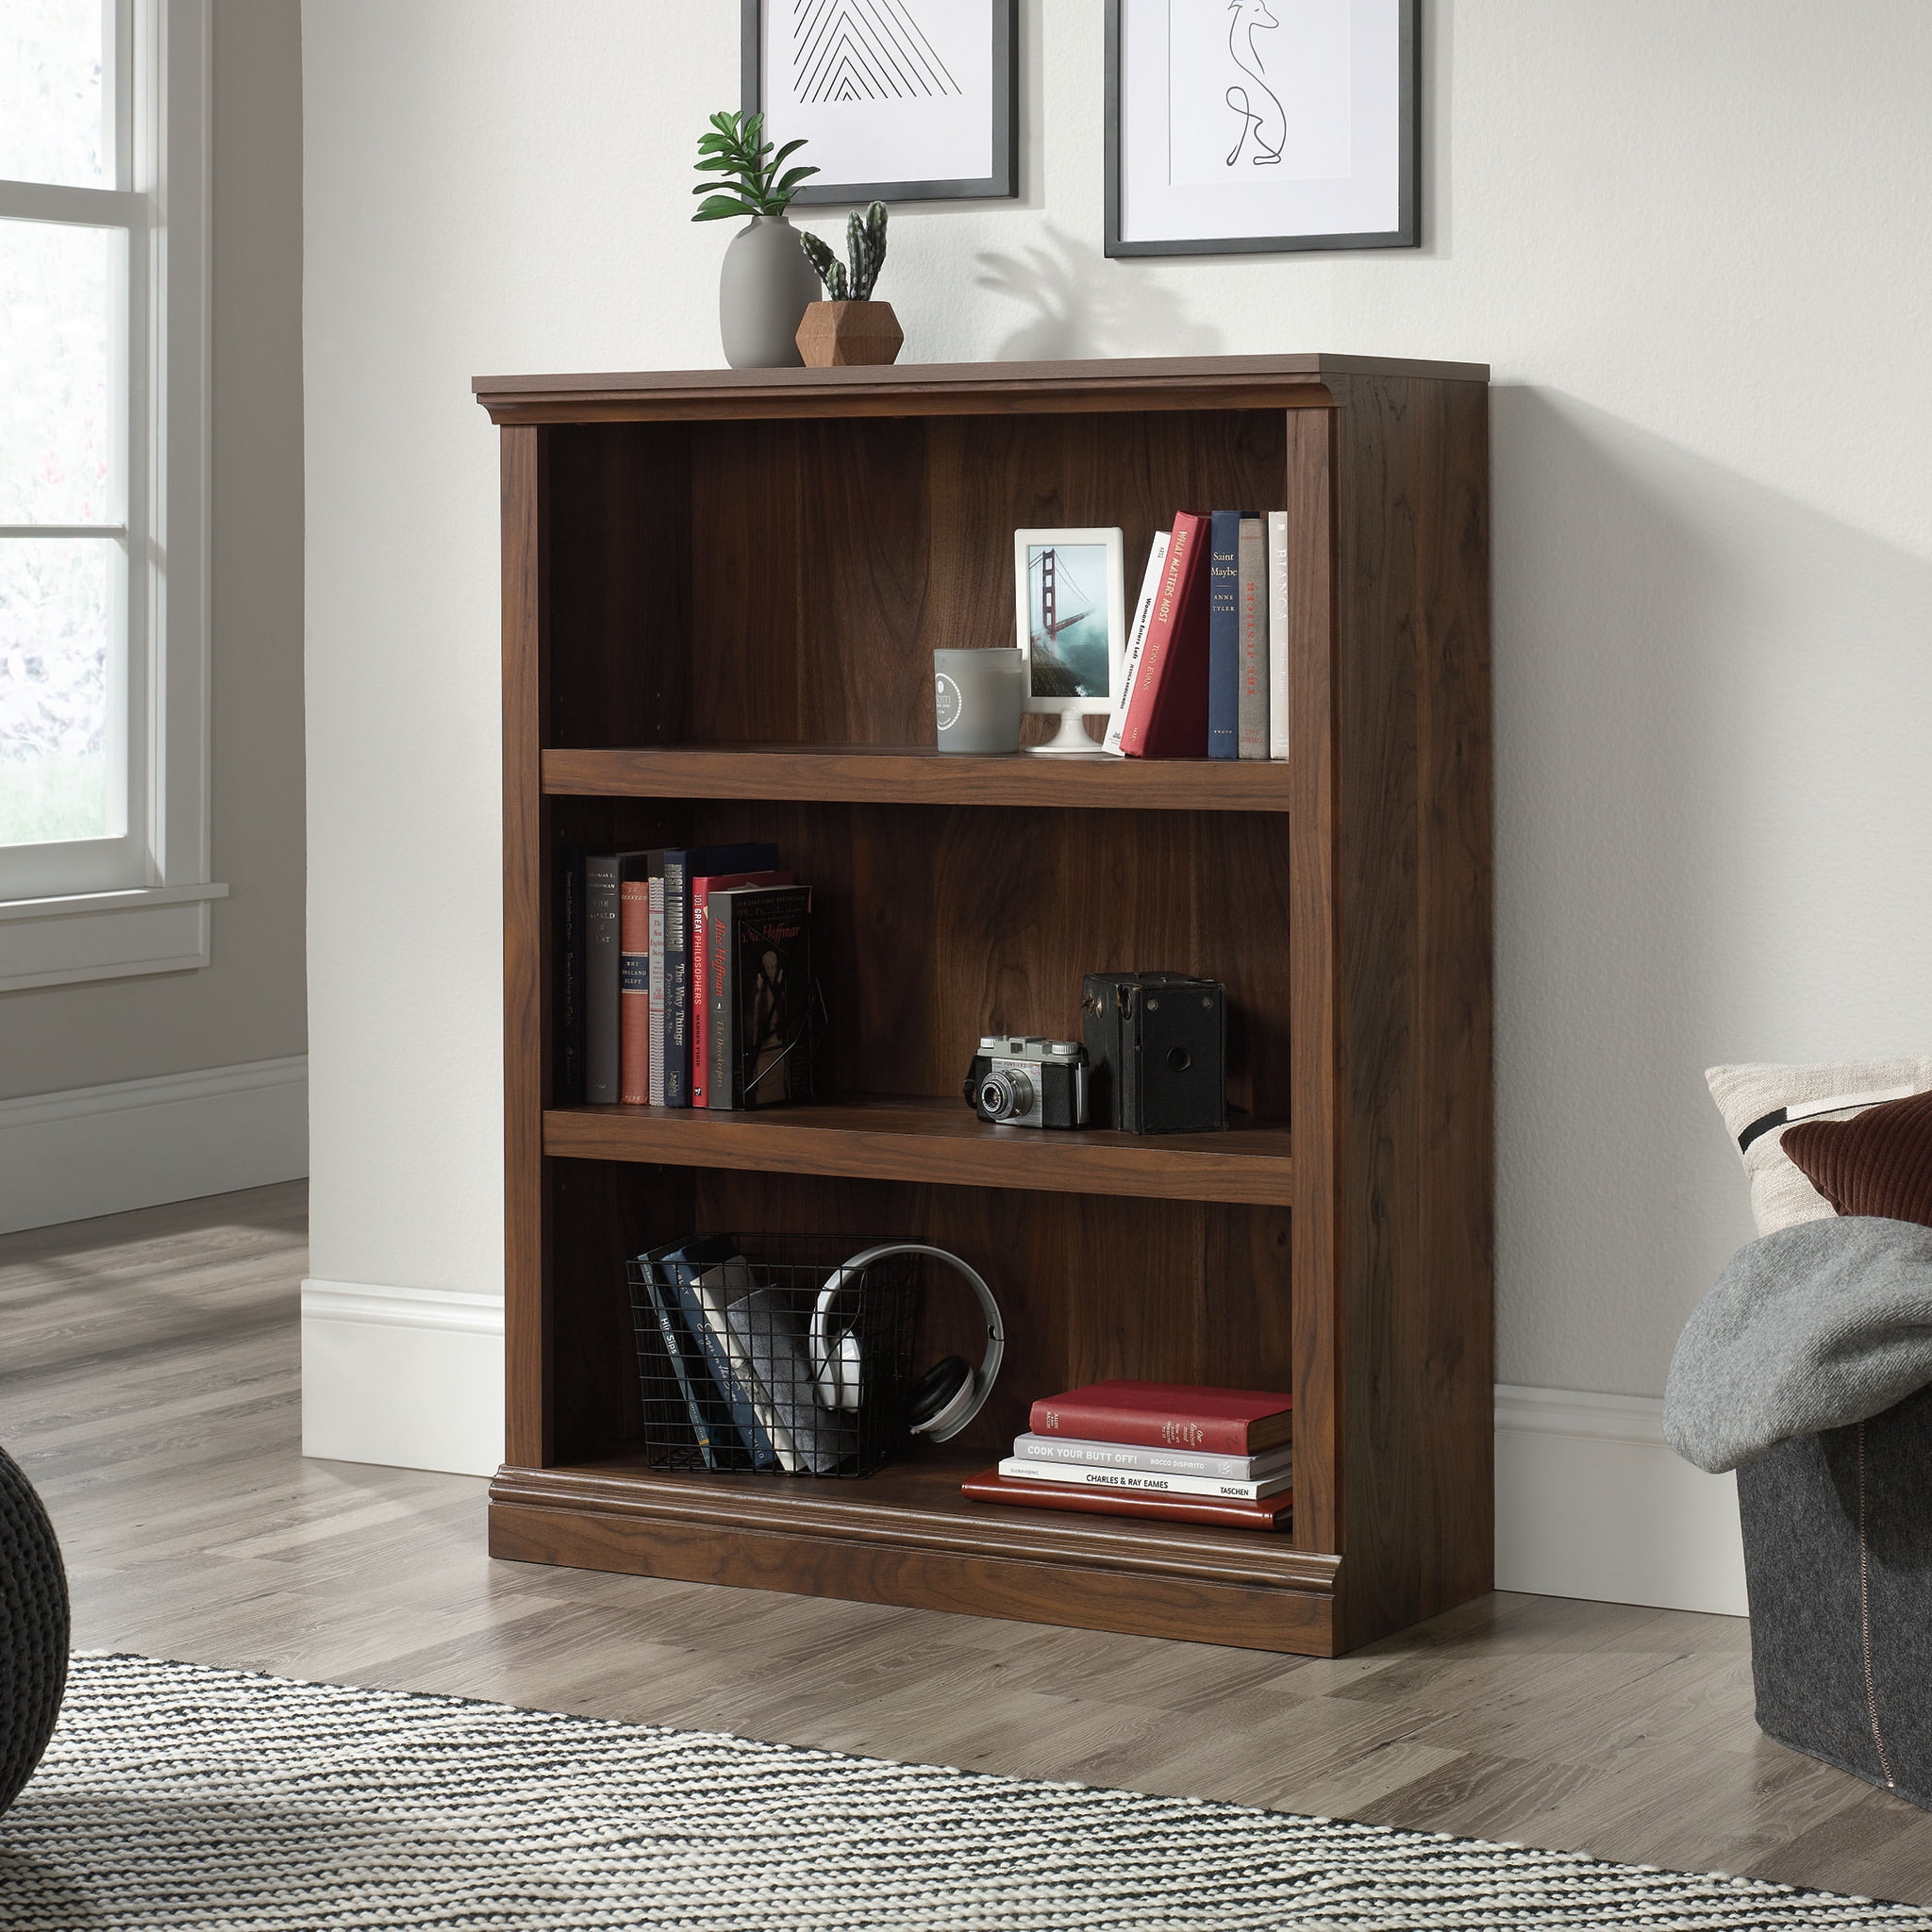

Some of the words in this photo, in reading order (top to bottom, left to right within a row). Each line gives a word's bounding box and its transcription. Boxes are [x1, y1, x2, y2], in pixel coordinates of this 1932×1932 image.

[1174, 530, 1188, 557] WHAT
[1213, 551, 1234, 561] Saint
[1164, 558, 1181, 597] MATTERS
[1211, 567, 1238, 578] Maybe
[1275, 549, 1287, 620] BIANCA
[1141, 598, 1152, 624] Woman
[1158, 598, 1171, 624] MOST
[1136, 625, 1145, 645] Enters
[1132, 645, 1141, 659] Left
[1149, 644, 1160, 666] TONY
[1142, 666, 1155, 691] EVANS
[665, 864, 683, 892] RUSH
[693, 894, 703, 906] 101
[665, 896, 684, 951] LIMBAUGH
[693, 908, 702, 933] GREAT
[714, 917, 725, 945] Alice
[675, 963, 685, 983] The
[693, 936, 702, 1005] PHILOSOPHERS
[712, 947, 726, 997] Hoffman
[674, 986, 685, 1008] Way
[674, 1010, 685, 1046] Things
[715, 1038, 724, 1088] Dovekeepers
[666, 1335, 677, 1355] Sips
[1027, 1445, 1054, 1456] COOK
[1057, 1448, 1083, 1458] YOUR
[1087, 1451, 1112, 1462] BUTT
[1115, 1454, 1138, 1464] OFF!
[1086, 1474, 1119, 1485] CHARLES
[1127, 1478, 1141, 1487] RAY
[1143, 1479, 1169, 1489] EAMES
[1220, 1487, 1249, 1496] TASCHEN
